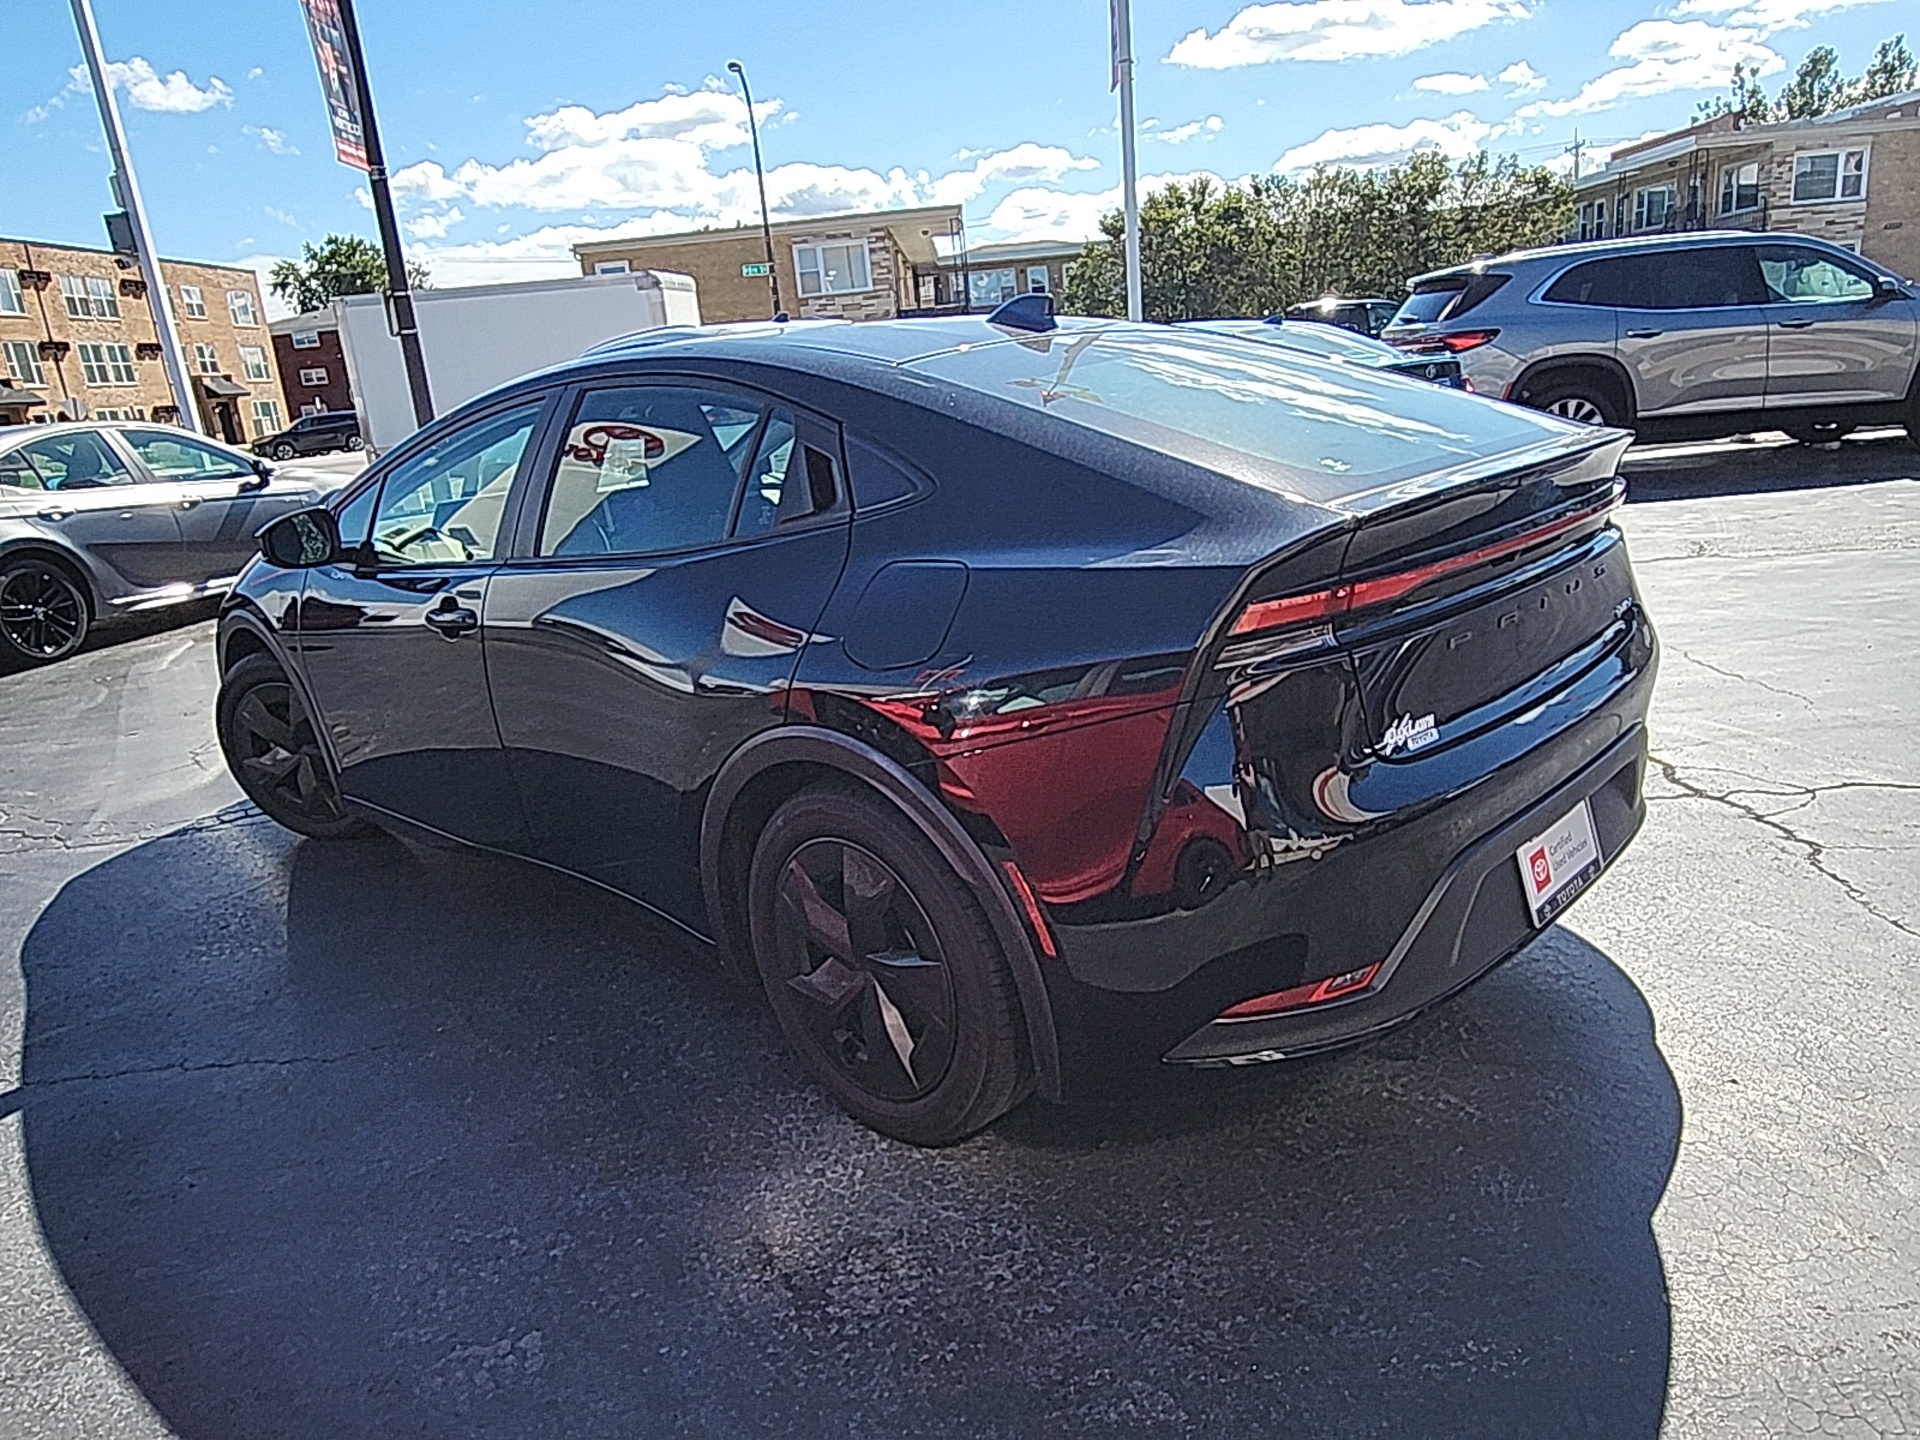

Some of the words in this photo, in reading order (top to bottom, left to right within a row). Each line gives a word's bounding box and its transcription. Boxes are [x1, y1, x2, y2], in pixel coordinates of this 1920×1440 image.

[1447, 565, 1606, 649] PRIUS
[1410, 731, 1436, 746] TOYOTA
[1549, 831, 1573, 856] Certified
[1552, 853, 1568, 872] Used
[1566, 839, 1588, 864] Vehicles
[1557, 876, 1584, 905] TOYOTA
